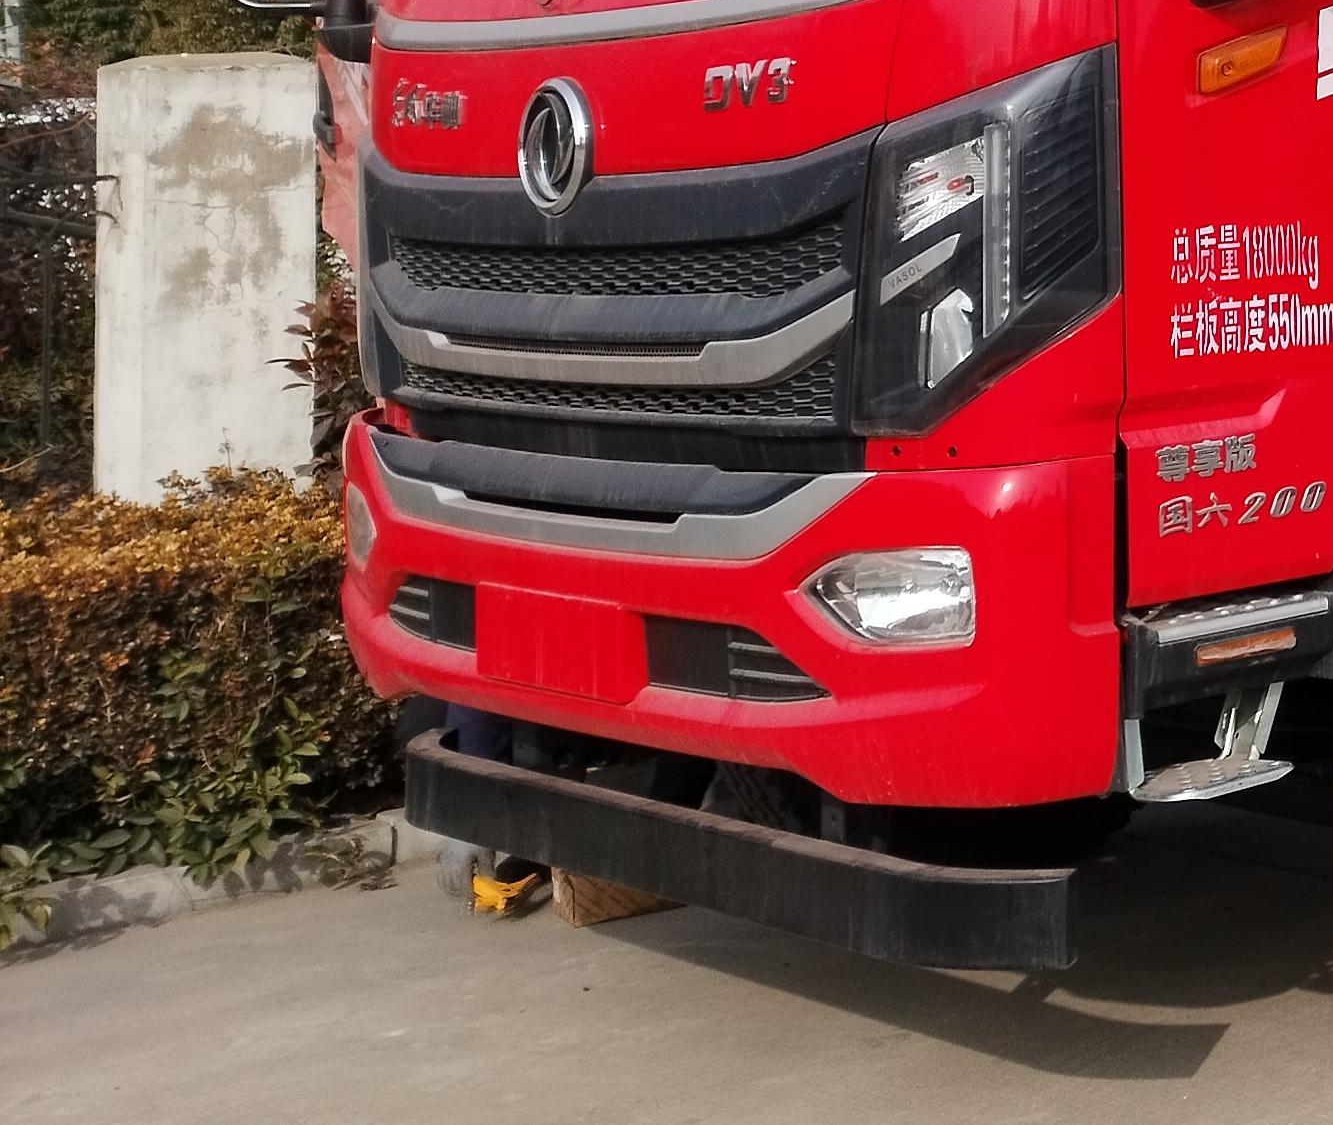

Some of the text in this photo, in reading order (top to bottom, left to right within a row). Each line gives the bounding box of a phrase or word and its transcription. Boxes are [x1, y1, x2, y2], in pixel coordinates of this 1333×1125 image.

[1170, 220, 1319, 290] 总质量18000kg
[1156, 433, 1257, 482] 尊享版
